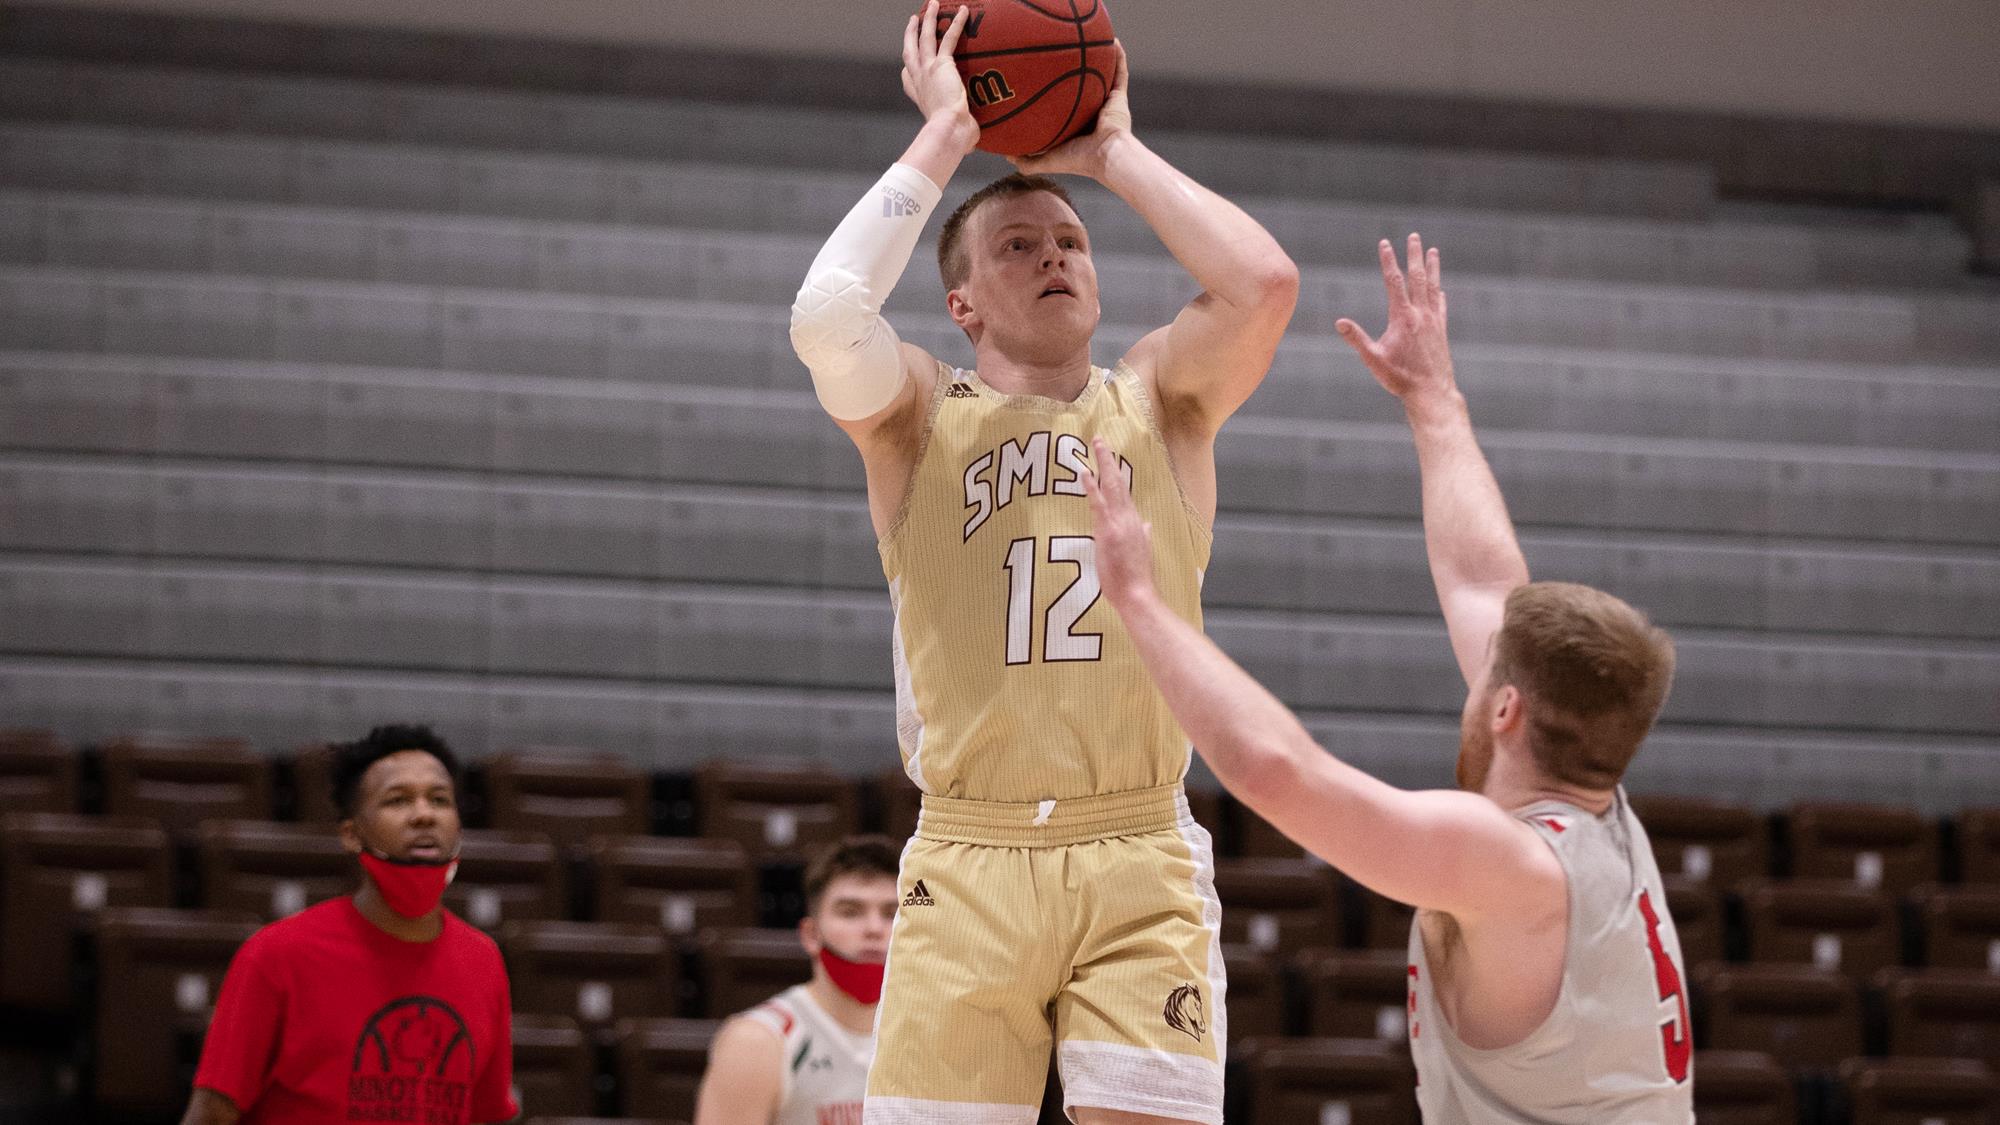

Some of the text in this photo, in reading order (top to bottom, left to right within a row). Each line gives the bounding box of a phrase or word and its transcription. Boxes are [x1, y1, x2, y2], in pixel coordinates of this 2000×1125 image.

[881, 185, 921, 214] adidas
[1003, 535, 1104, 666] 12
[902, 896, 935, 907] adidas
[1636, 886, 1693, 1085] 5
[424, 1079, 471, 1109] STAT
